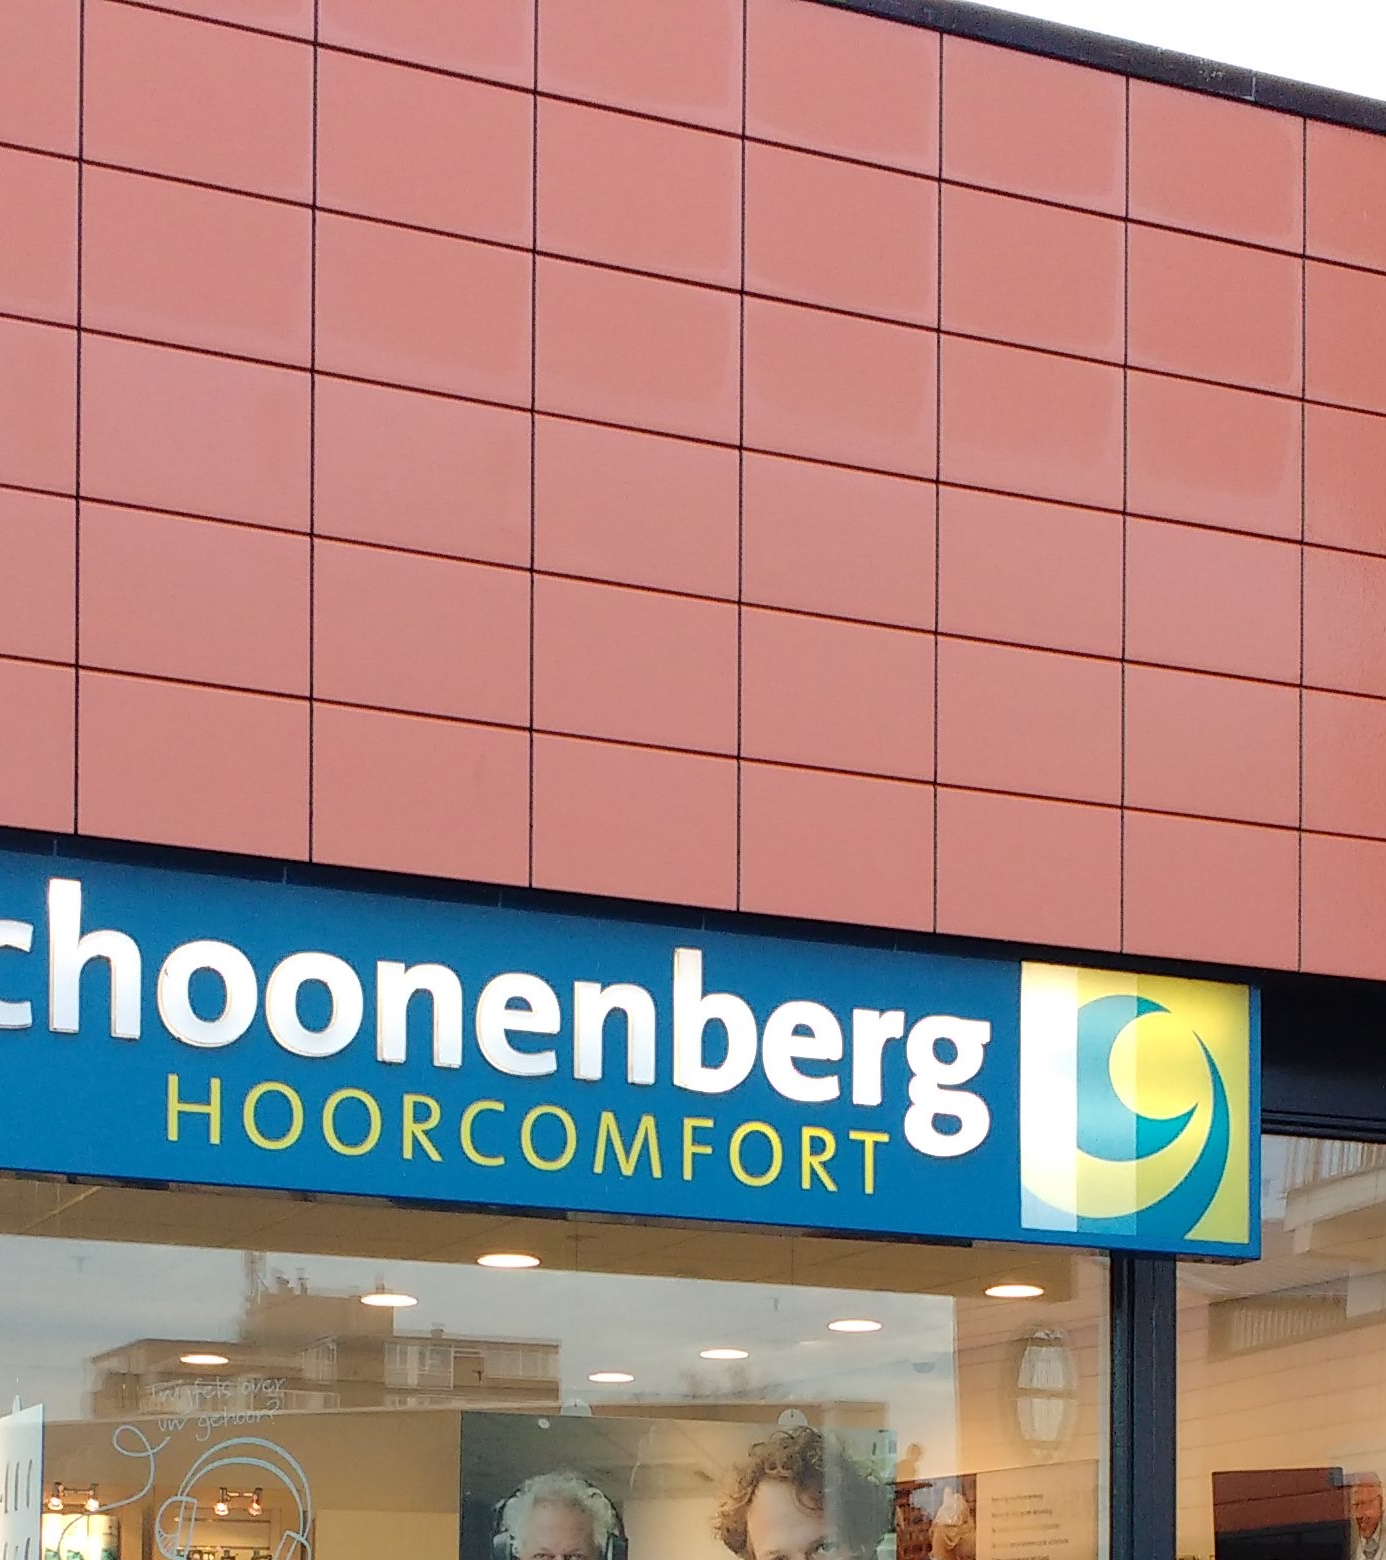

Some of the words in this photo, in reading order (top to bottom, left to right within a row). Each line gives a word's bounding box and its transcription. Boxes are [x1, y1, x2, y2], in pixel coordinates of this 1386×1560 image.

[165, 1073, 890, 1194] HOORCOMFORT
[241, 1376, 287, 1395] over
[157, 1417, 187, 1432] uw
[195, 1399, 282, 1442] gehoor?
